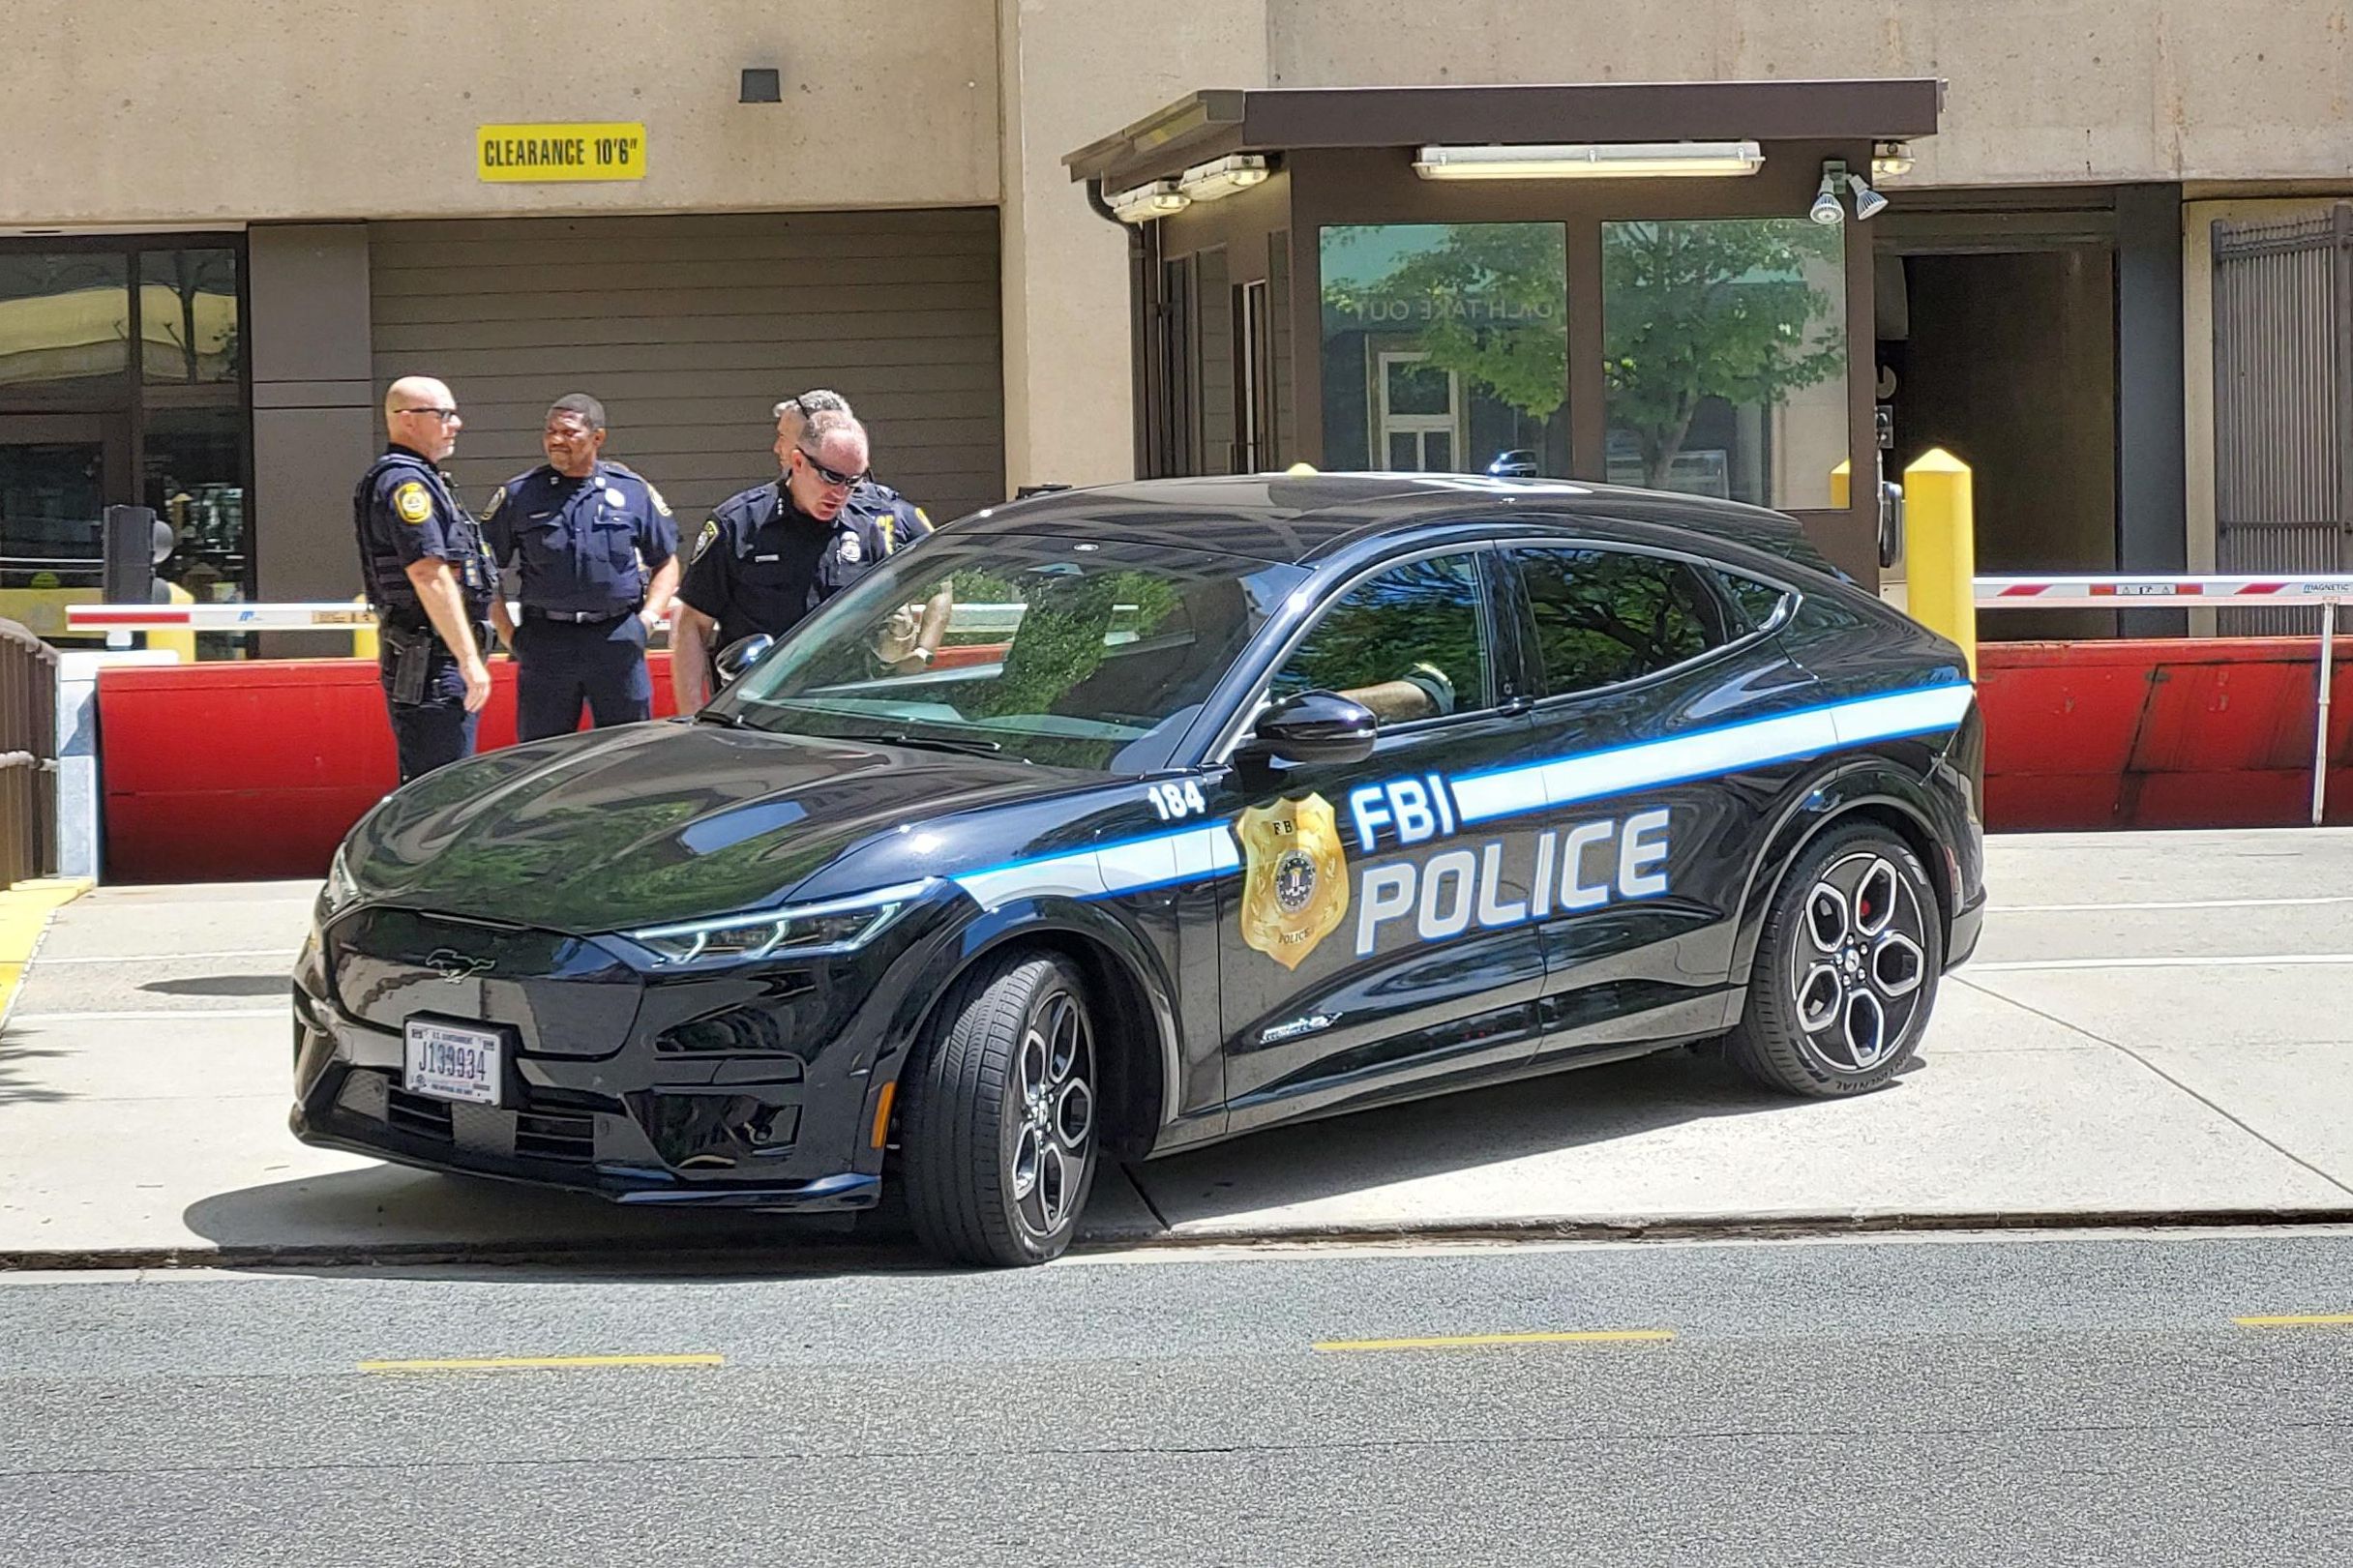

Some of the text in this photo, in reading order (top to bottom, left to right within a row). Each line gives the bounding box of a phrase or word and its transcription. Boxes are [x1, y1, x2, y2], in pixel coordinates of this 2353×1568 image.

[484, 138, 585, 166] CLEARANCE
[1147, 780, 1206, 820] 184
[1350, 772, 1455, 851] FBI
[1356, 808, 1670, 957] POLICE
